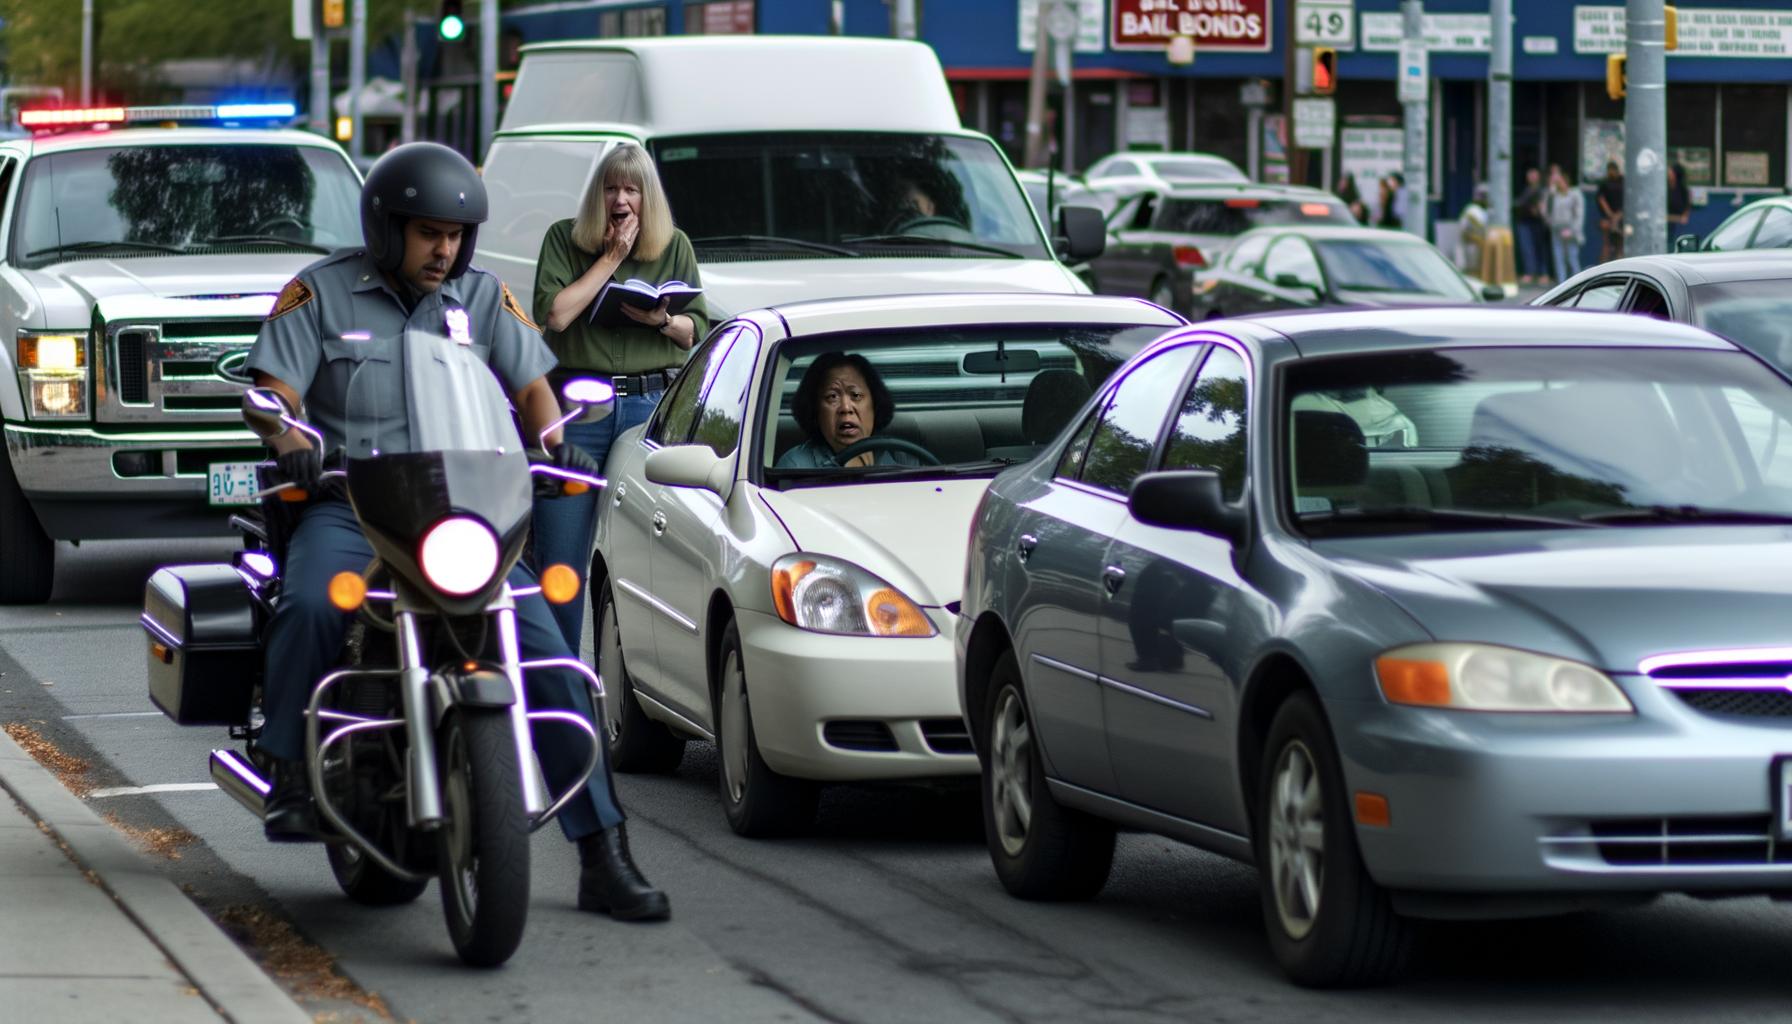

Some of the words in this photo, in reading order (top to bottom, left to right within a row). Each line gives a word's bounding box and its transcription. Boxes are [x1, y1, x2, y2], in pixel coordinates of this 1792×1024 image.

[1121, 12, 1176, 36] BAIL
[1178, 12, 1262, 38] BONDS
[1304, 11, 1343, 37] 49
